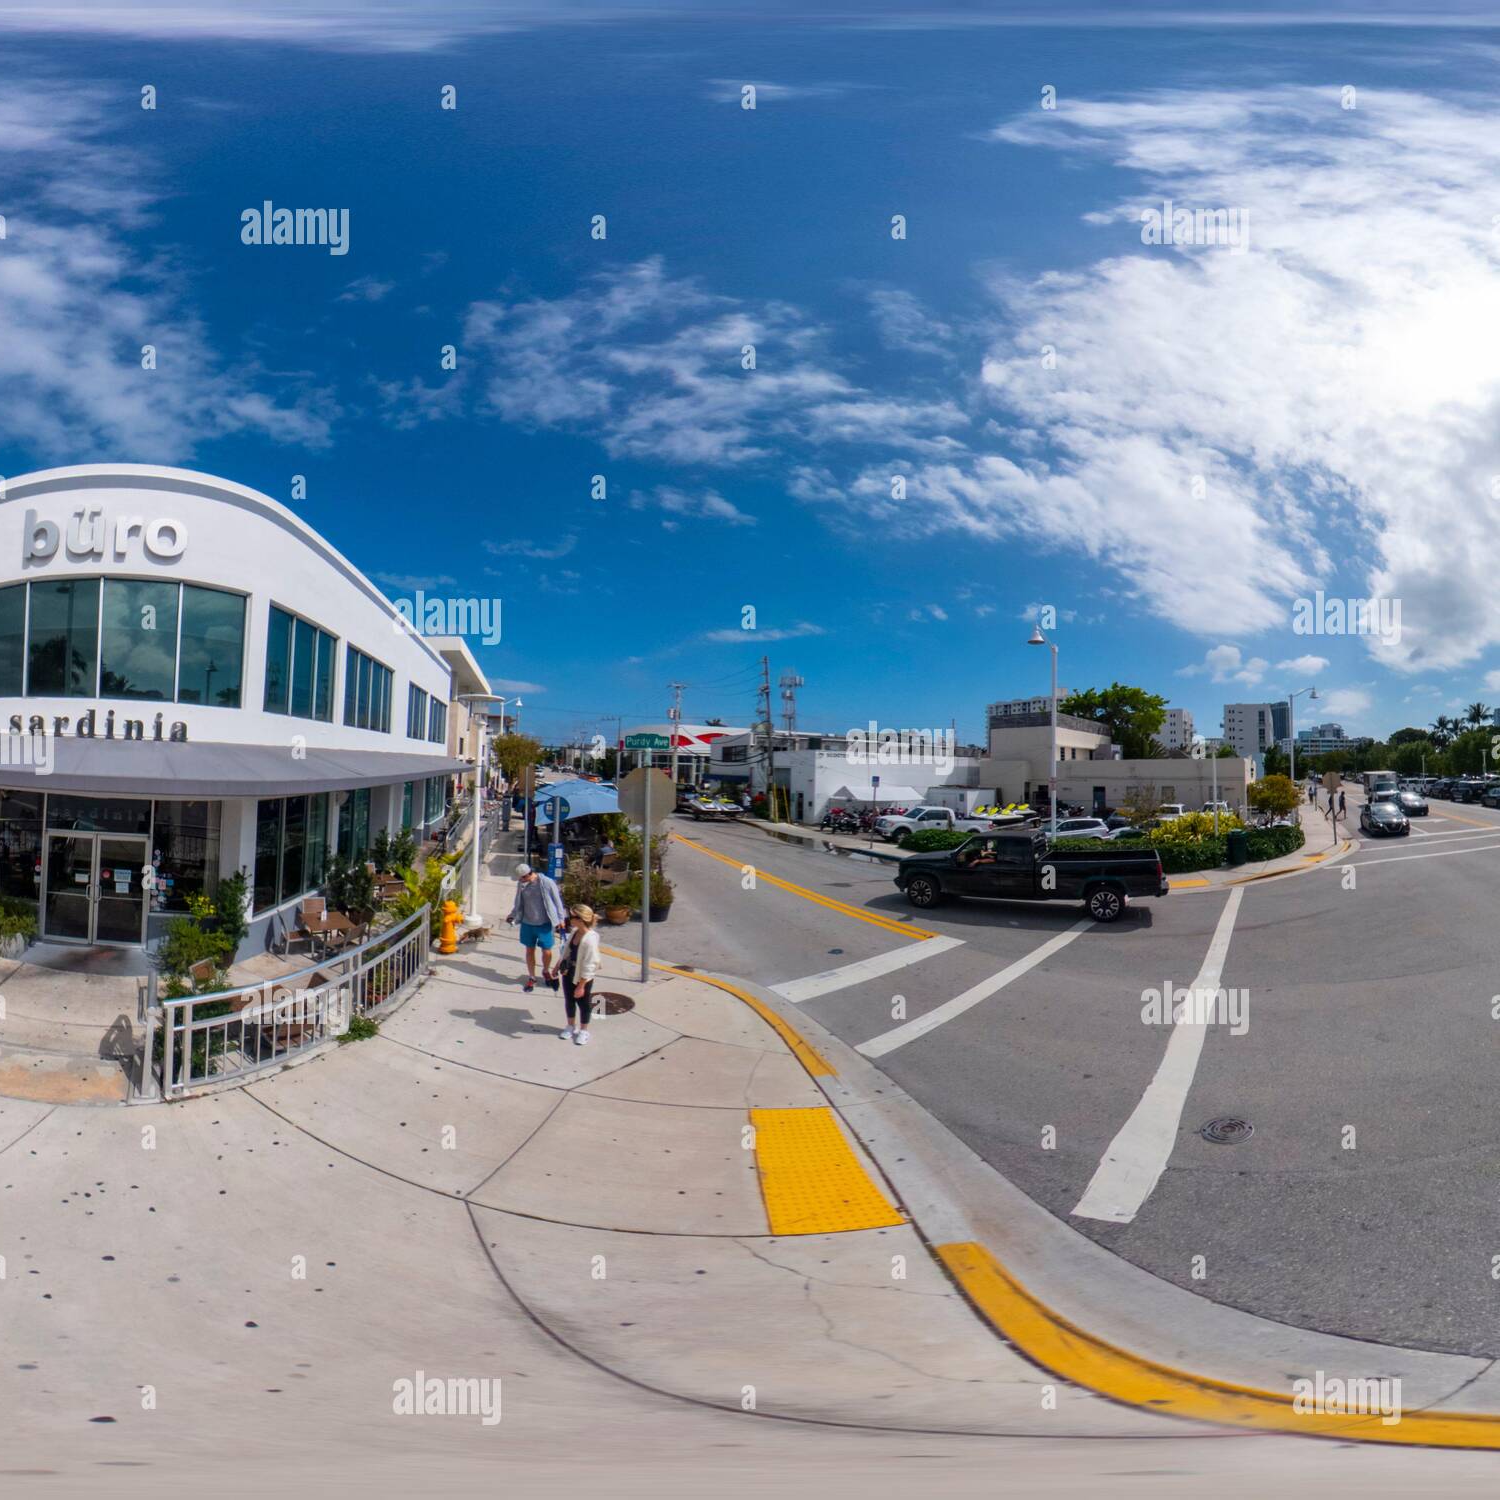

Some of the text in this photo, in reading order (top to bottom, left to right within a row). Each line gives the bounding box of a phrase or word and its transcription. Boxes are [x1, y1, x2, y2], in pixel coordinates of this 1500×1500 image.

[24, 504, 189, 557] büro
[9, 709, 188, 742] sardinia
[627, 737, 669, 746] Purdy Ave
